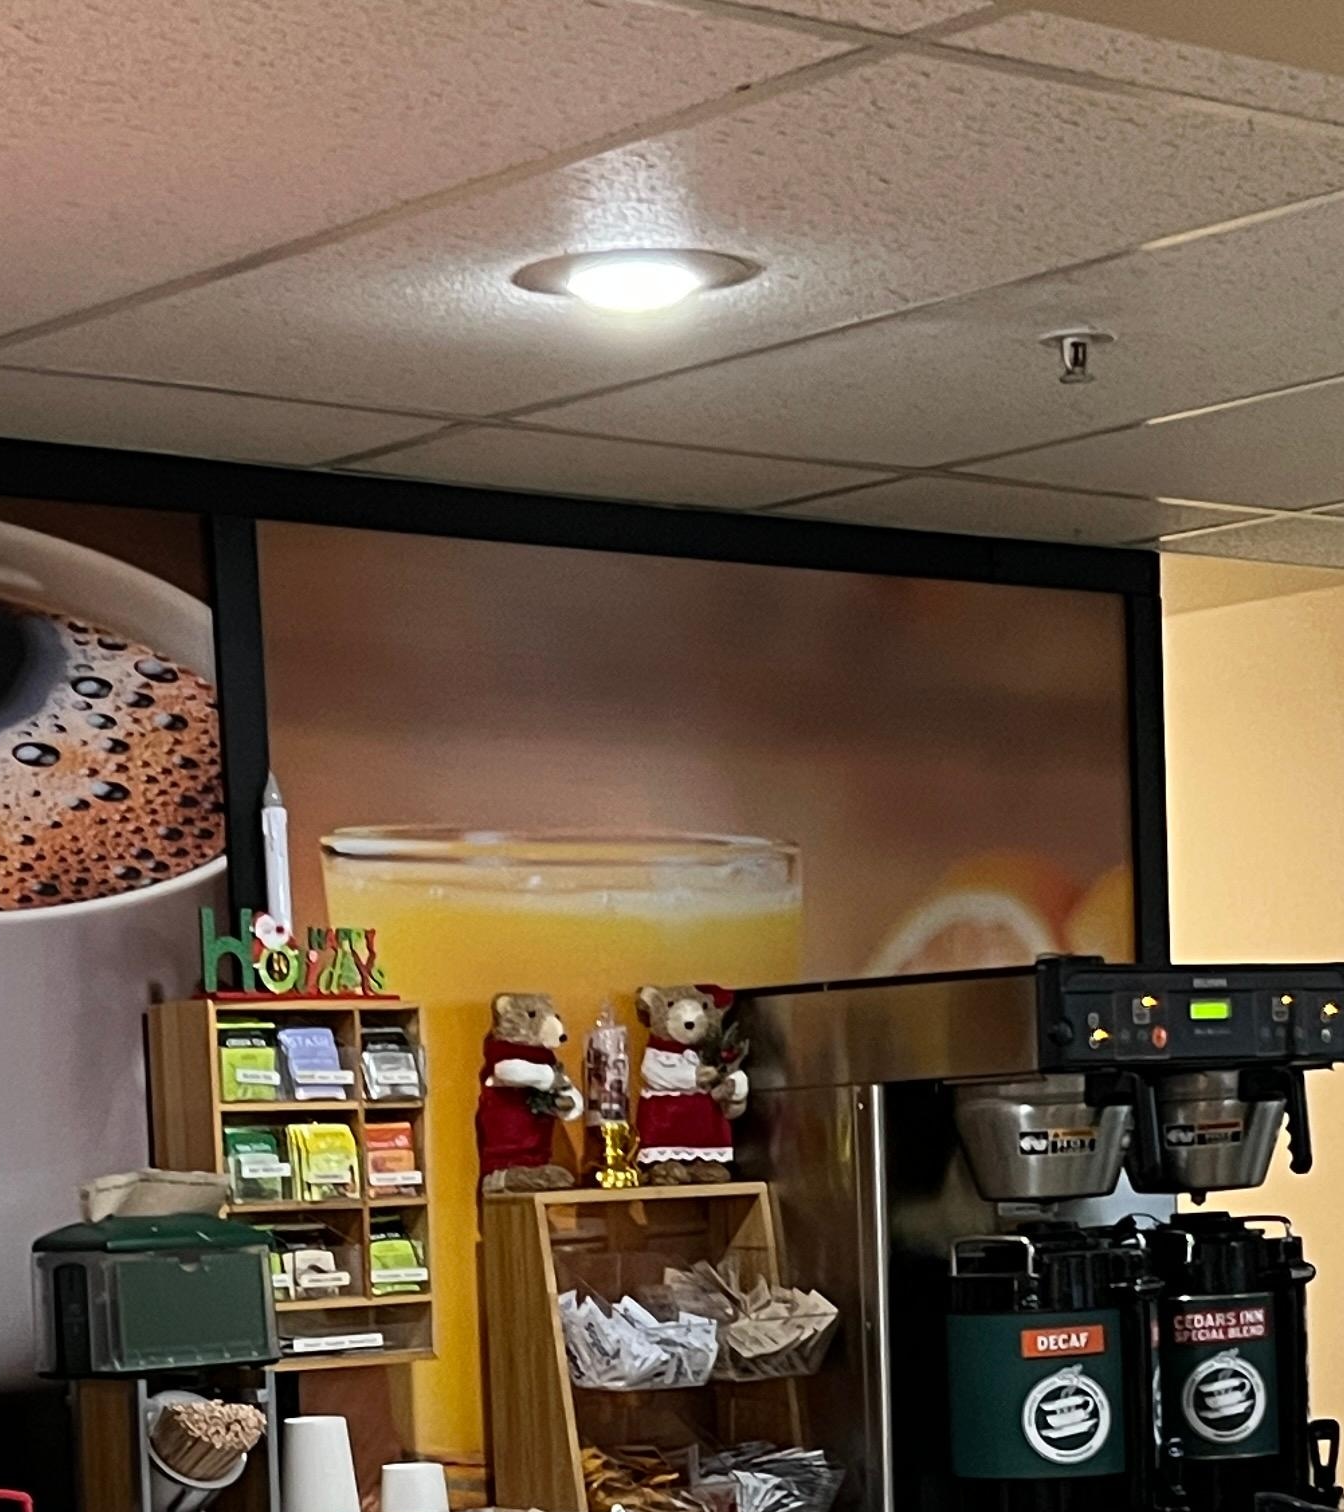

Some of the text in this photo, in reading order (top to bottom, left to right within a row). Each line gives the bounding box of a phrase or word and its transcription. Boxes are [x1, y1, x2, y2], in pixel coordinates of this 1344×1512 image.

[1174, 1309, 1265, 1330] CEDARS INN
[1036, 1332, 1089, 1352] DECAF
[1174, 1324, 1265, 1343] SPECIAL BLEND
